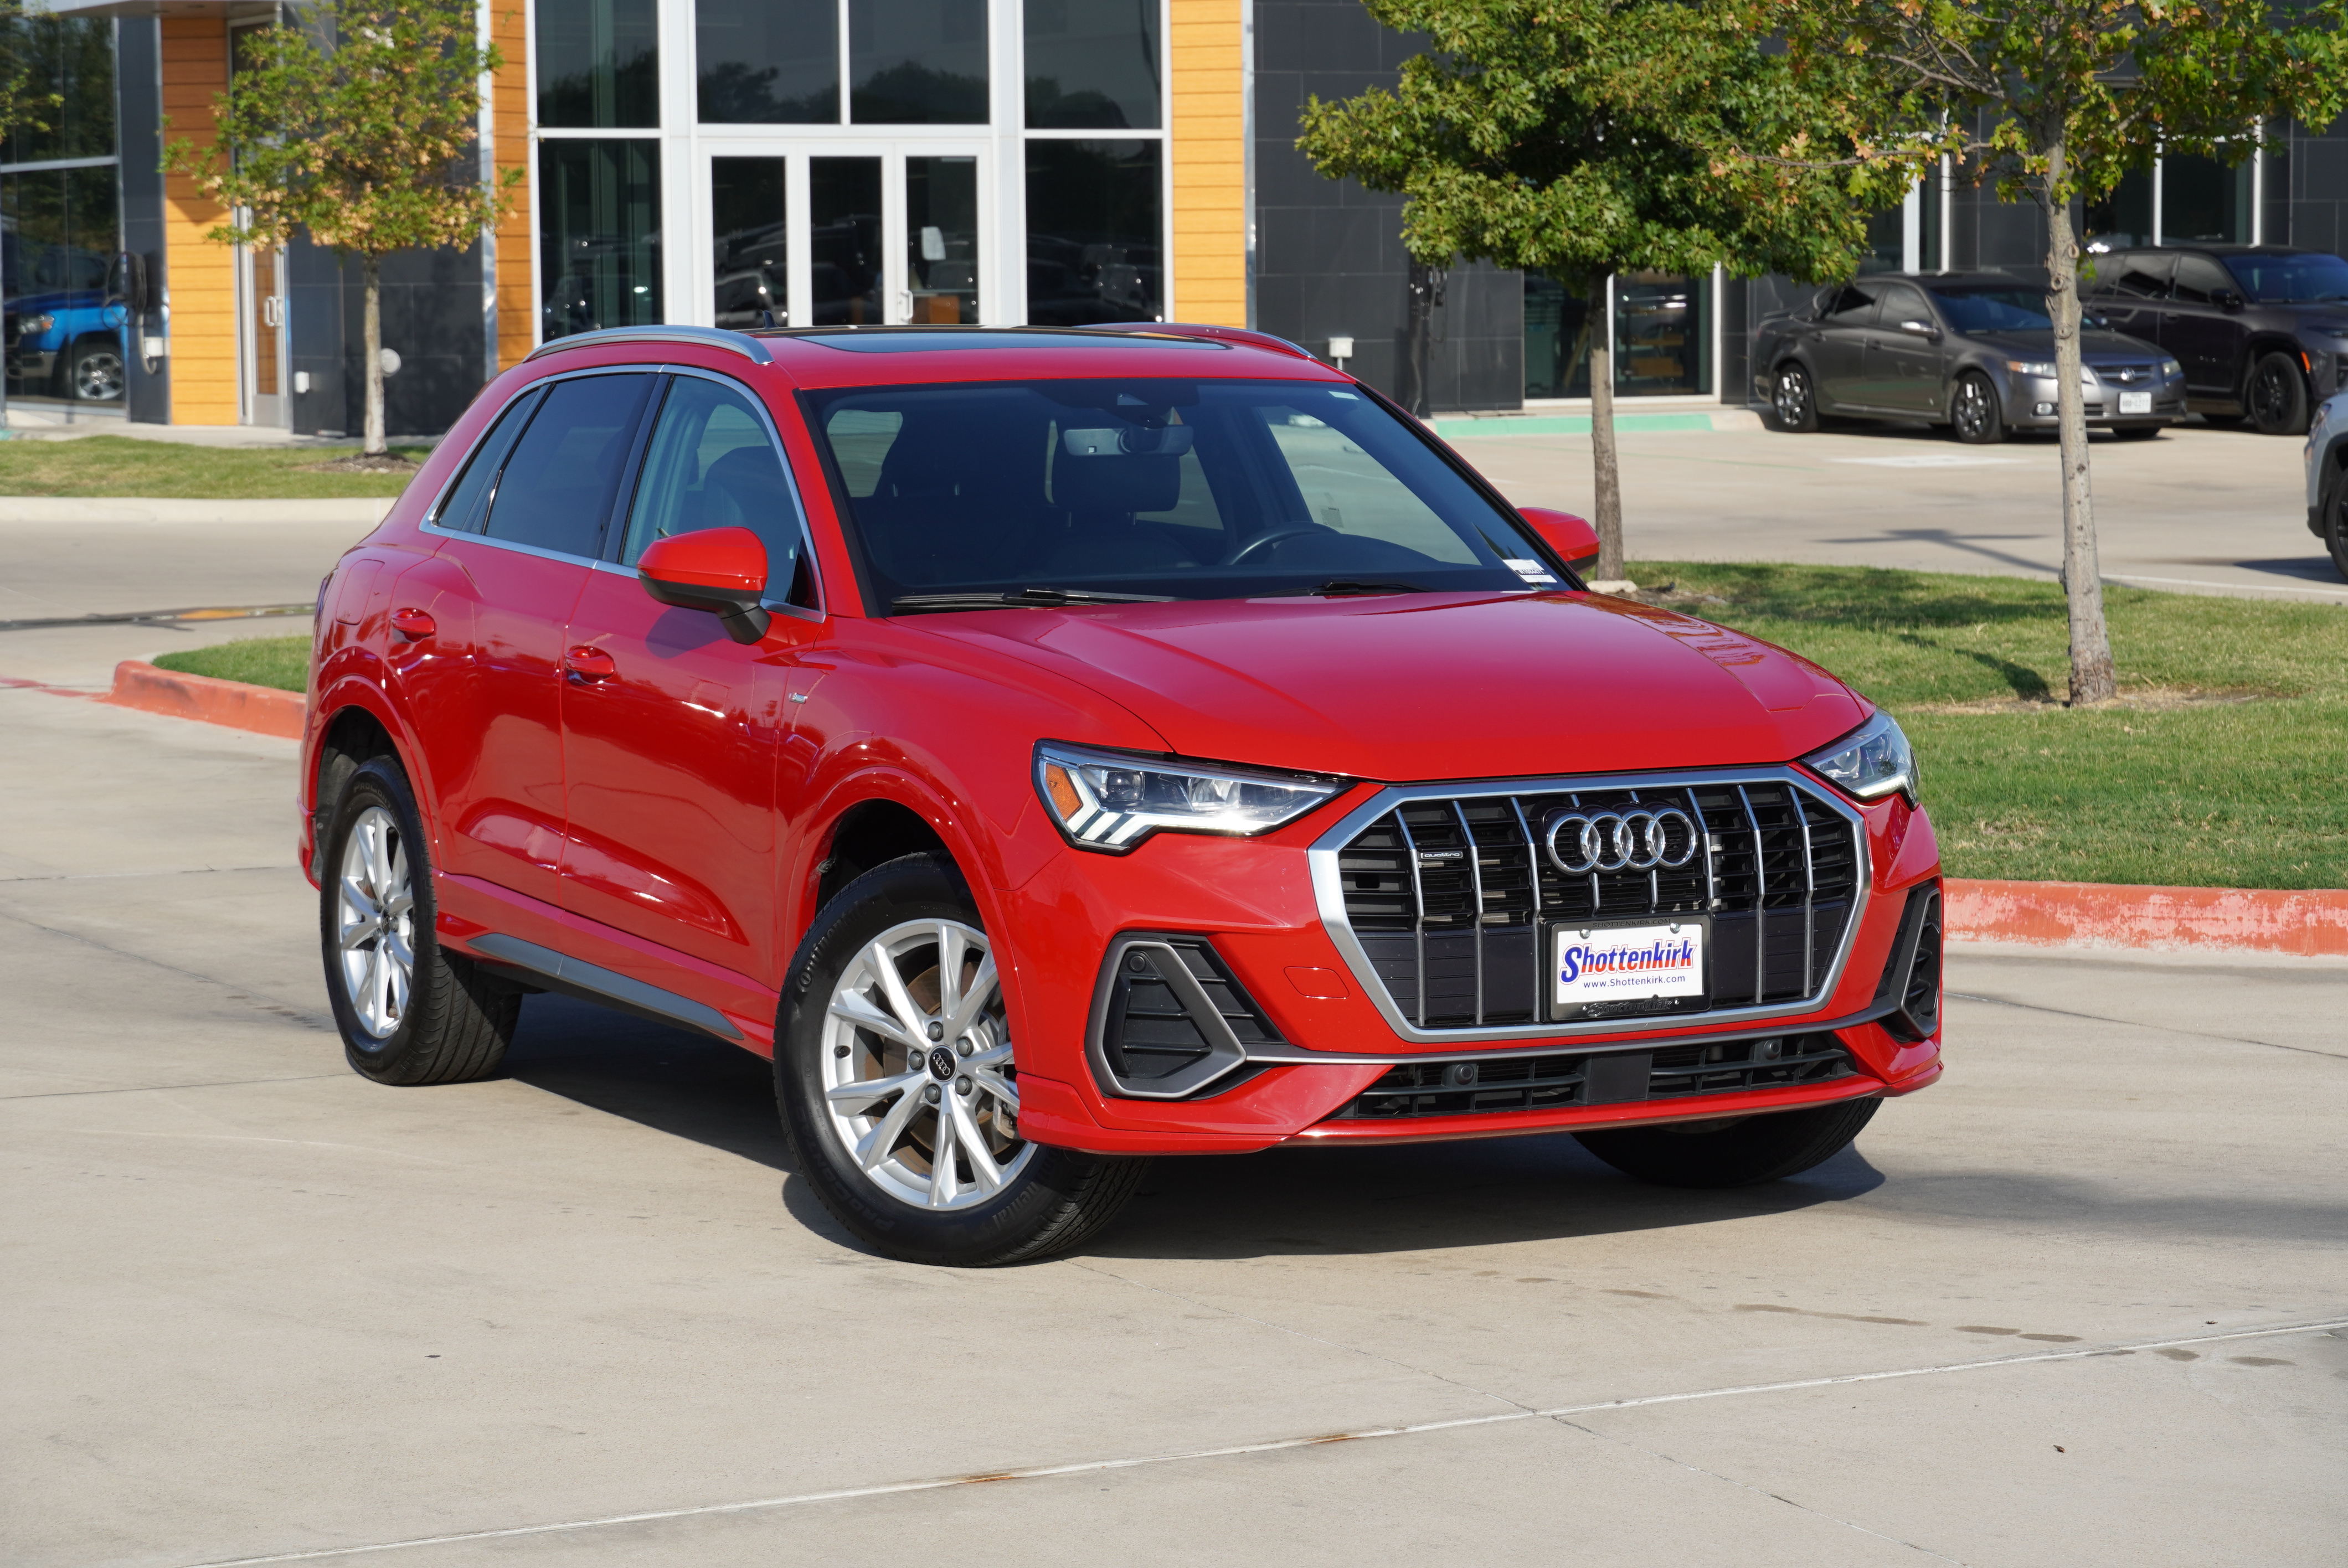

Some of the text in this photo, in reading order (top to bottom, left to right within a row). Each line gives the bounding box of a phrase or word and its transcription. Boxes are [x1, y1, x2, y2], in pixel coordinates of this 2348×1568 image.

[1592, 918, 1671, 929] SHOTTENKIRK.COM
[1561, 939, 1695, 983] Shottenkirk
[1583, 974, 1686, 988] www.Shottenkirk.com
[1587, 999, 1672, 1017] Shottenkirk
